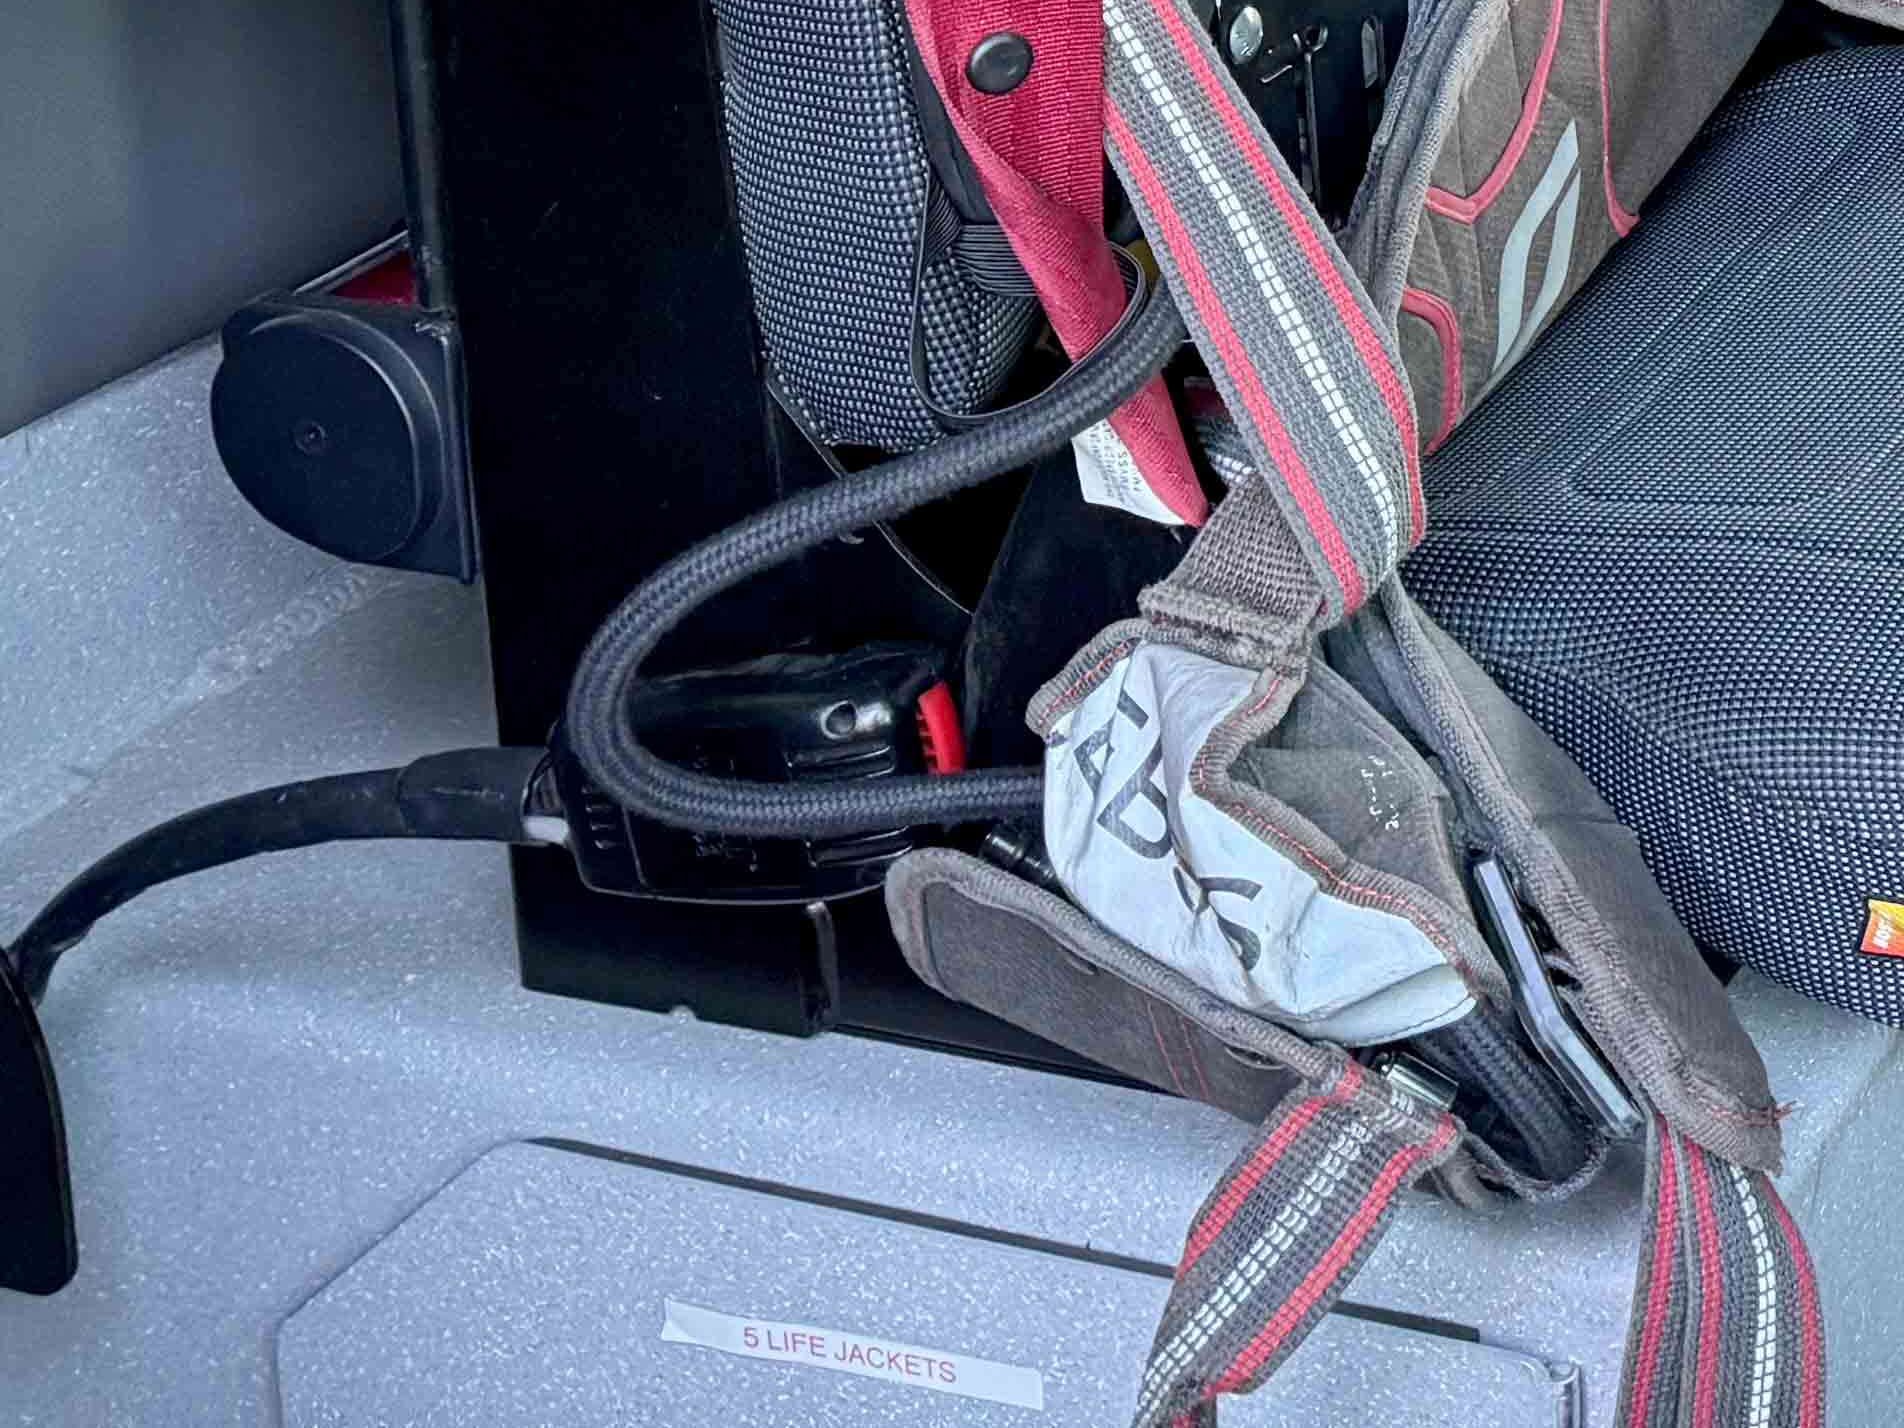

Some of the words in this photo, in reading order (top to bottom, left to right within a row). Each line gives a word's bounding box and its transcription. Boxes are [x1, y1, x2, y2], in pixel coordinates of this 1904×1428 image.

[743, 1327, 759, 1348] 5
[767, 1330, 827, 1359] LIFE
[834, 1341, 957, 1384] JACKETS
